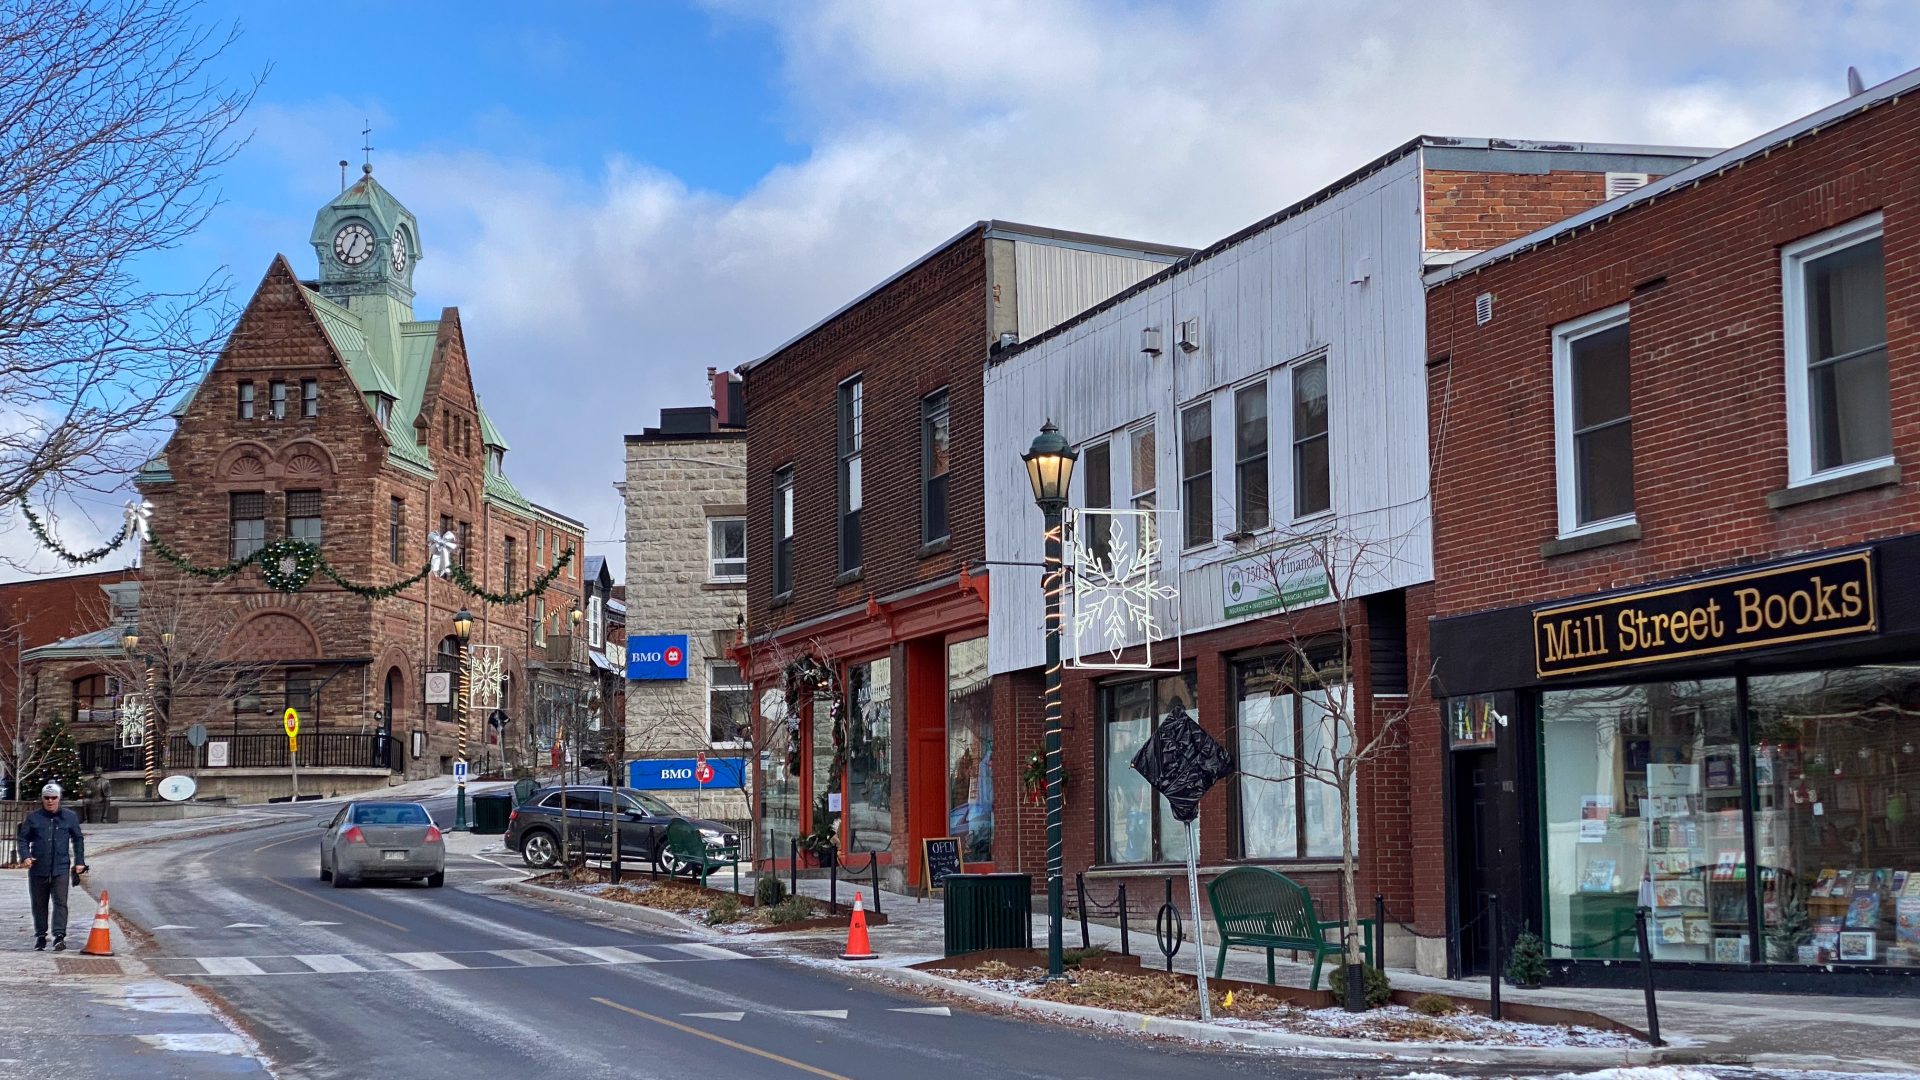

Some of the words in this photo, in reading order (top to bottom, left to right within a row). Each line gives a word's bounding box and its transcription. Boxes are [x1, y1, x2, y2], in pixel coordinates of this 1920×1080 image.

[1542, 614, 1608, 662] Mill
[1617, 598, 1724, 651] Street
[1734, 576, 1863, 634] Books
[632, 652, 661, 663] BMO
[661, 769, 692, 779] BMO
[932, 841, 955, 854] OPEN
